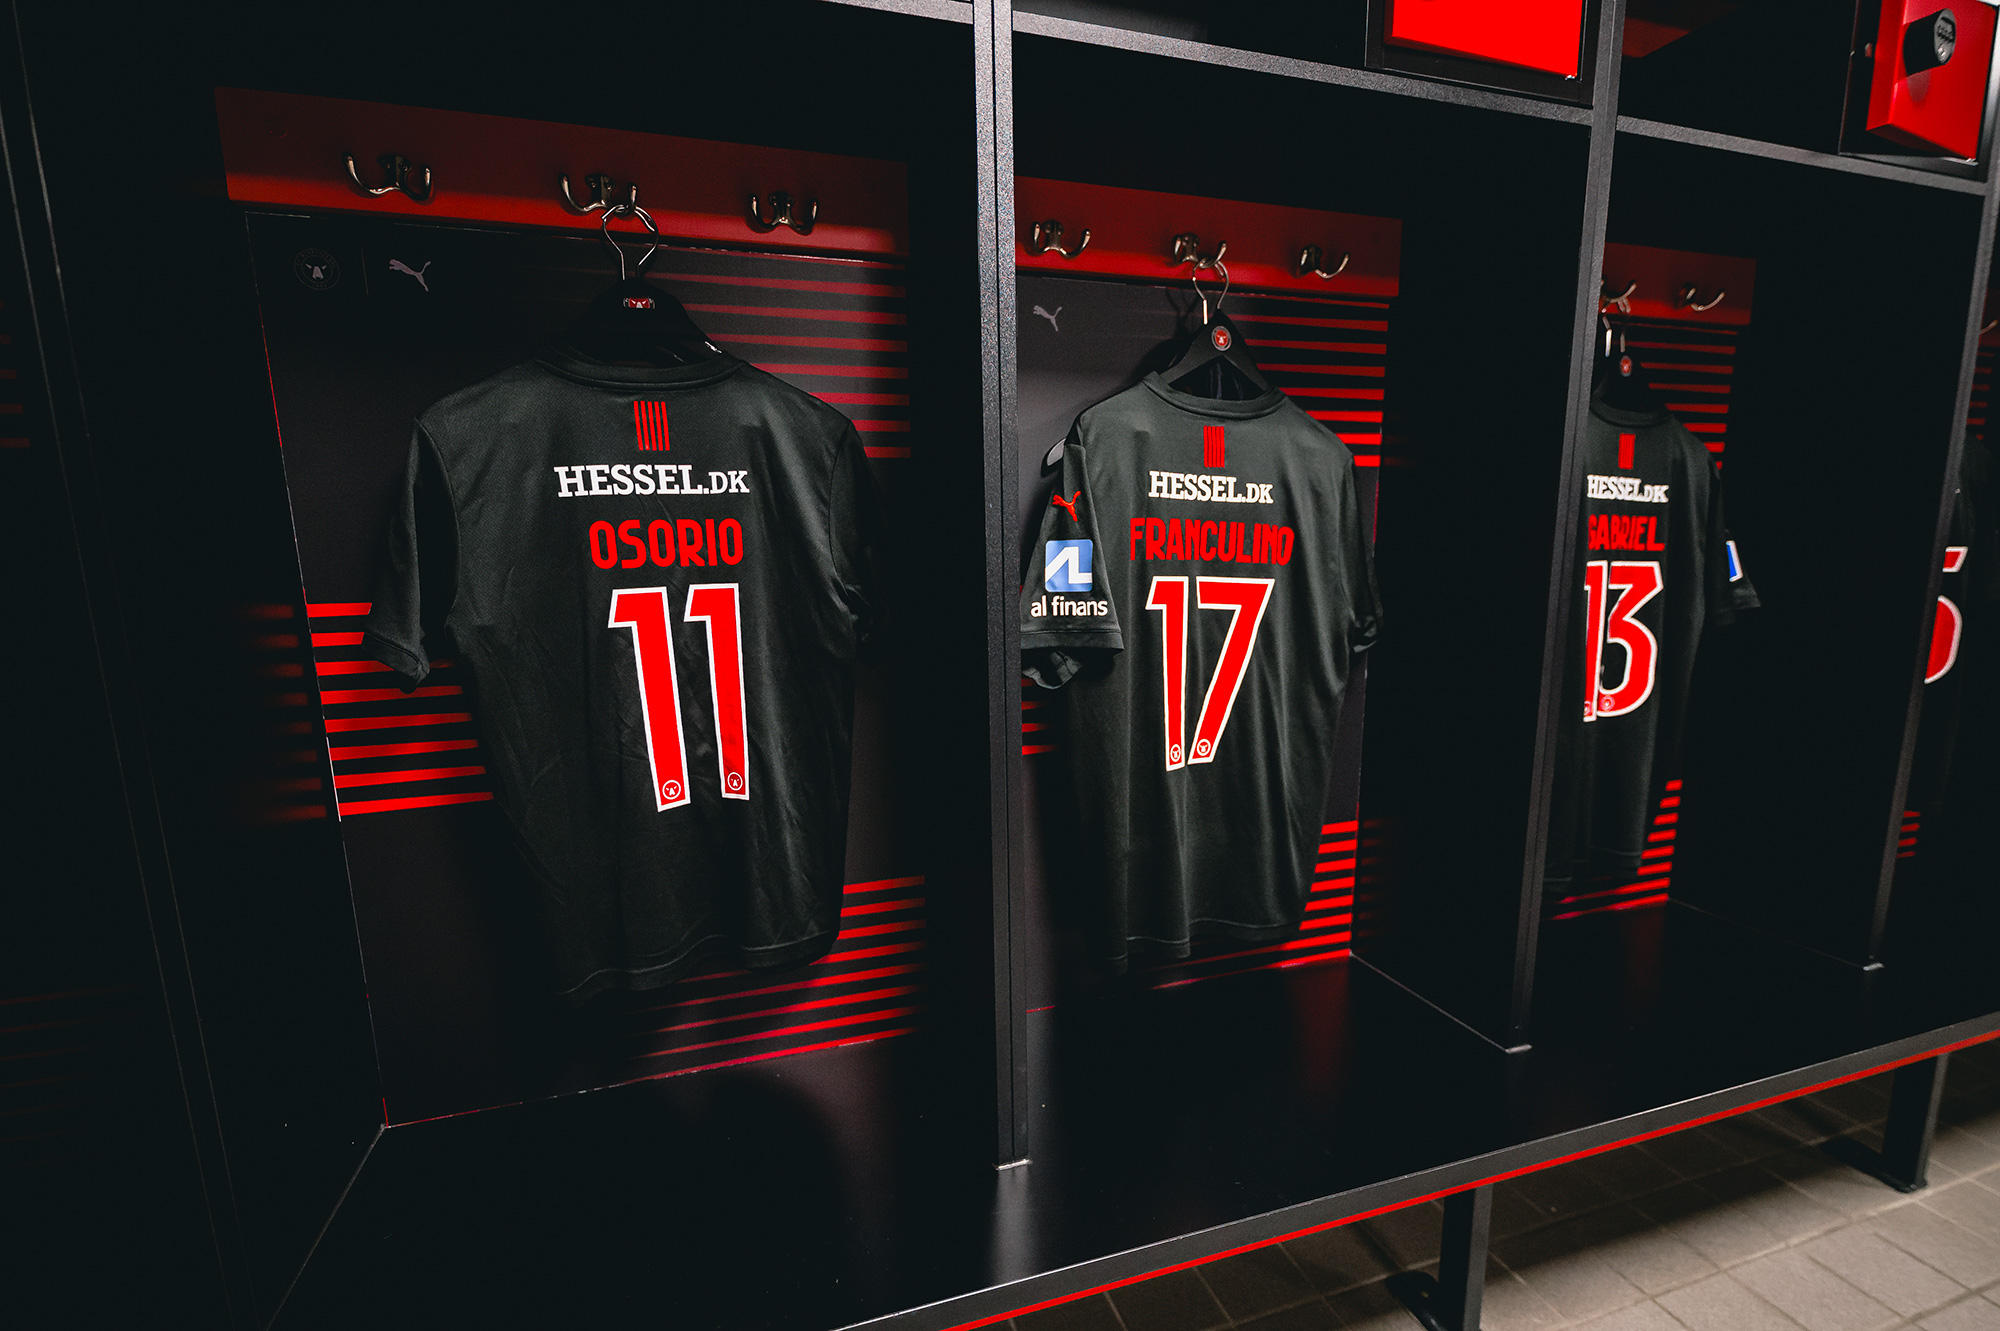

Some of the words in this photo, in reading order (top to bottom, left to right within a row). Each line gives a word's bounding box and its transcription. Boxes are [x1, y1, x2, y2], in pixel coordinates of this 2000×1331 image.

[554, 464, 750, 498] HESSEL.DK
[1148, 470, 1275, 504] HESSEL.DK
[1587, 474, 1670, 503] HESSEL.DK
[588, 517, 744, 570] OSORIO
[1129, 516, 1296, 567] FRANCULINO
[1030, 594, 1048, 618] al
[1051, 594, 1109, 617] finans
[1583, 559, 1665, 723] 13
[607, 582, 750, 813] 11
[1145, 575, 1276, 772] 17
